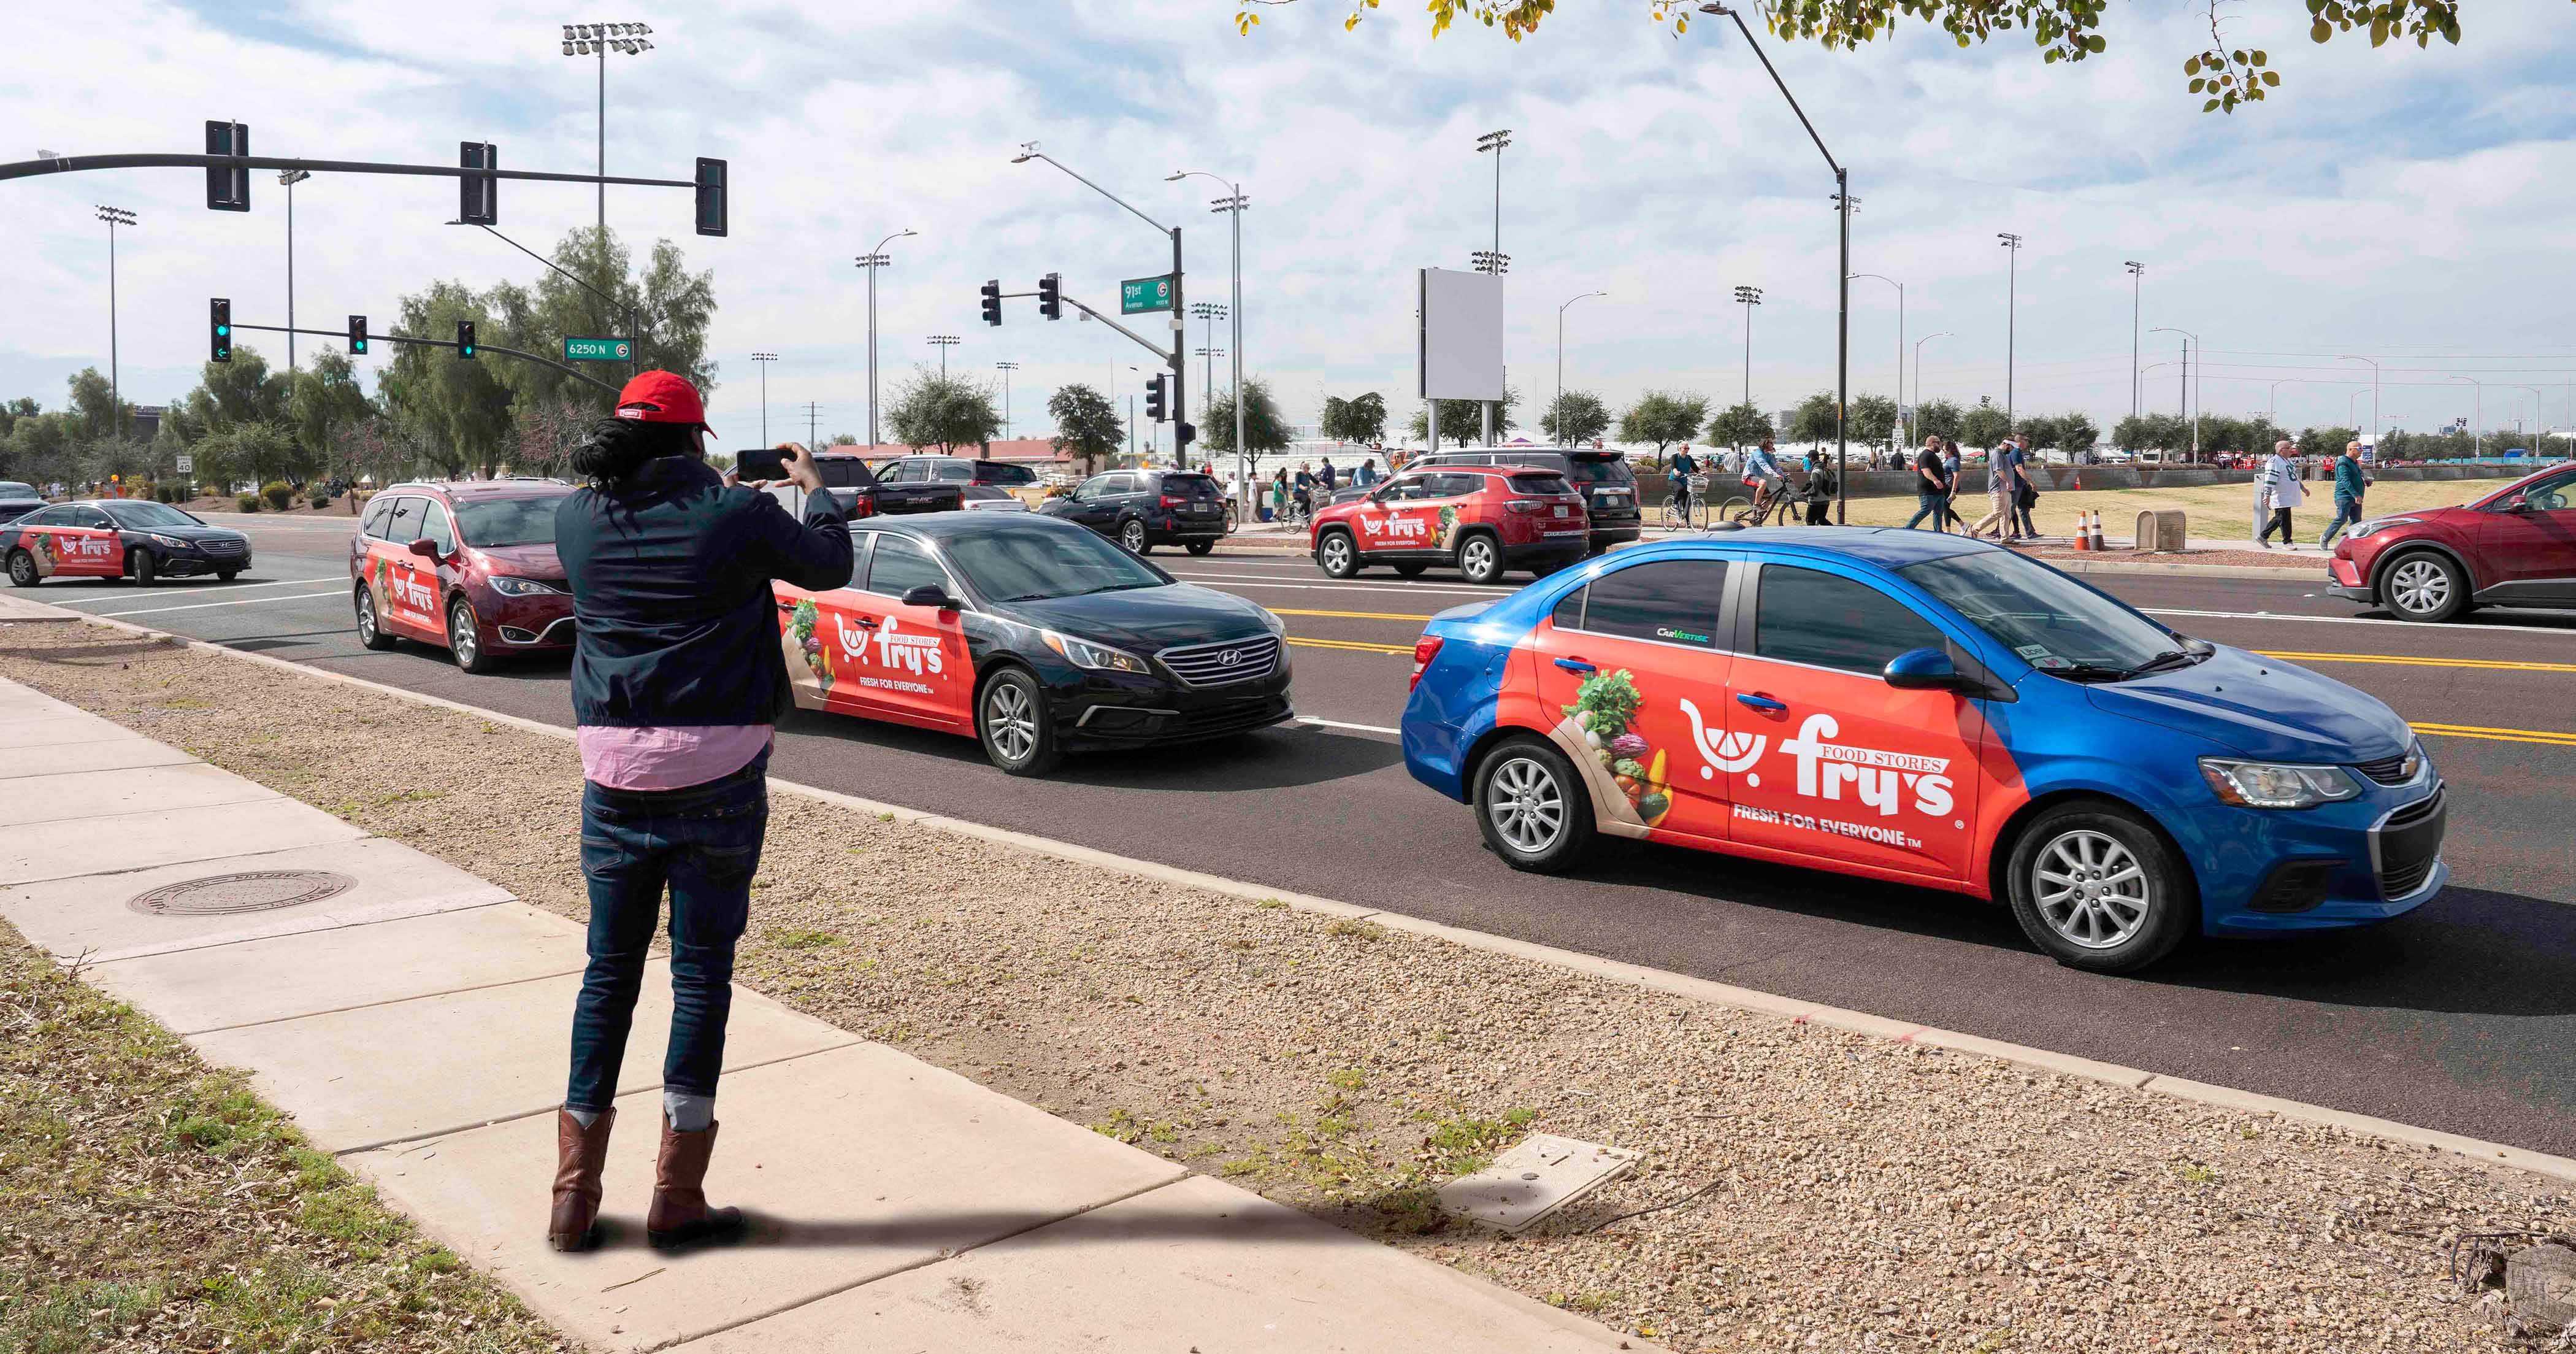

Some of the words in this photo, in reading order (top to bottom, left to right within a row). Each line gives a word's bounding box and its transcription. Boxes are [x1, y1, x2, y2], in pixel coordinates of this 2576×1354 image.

[1125, 285, 1141, 299] 91st
[569, 344, 596, 354] 6250
[599, 345, 605, 354] N
[1384, 512, 1425, 537] fry's
[78, 534, 110, 556] fry's
[405, 571, 433, 612] fry's
[873, 615, 942, 675] fry's
[891, 635, 908, 644] FOOD
[911, 637, 937, 646] STORES
[859, 677, 879, 688] FRESH
[879, 679, 894, 690] FOR
[894, 680, 928, 694] EVERYONE
[1778, 714, 1953, 816] fry's
[1822, 745, 1868, 762] FOOD
[1874, 752, 1942, 772] STORES
[1733, 804, 1780, 825] FRESH
[1783, 812, 1817, 830] FOR
[1819, 818, 1904, 846] EVERYONE
